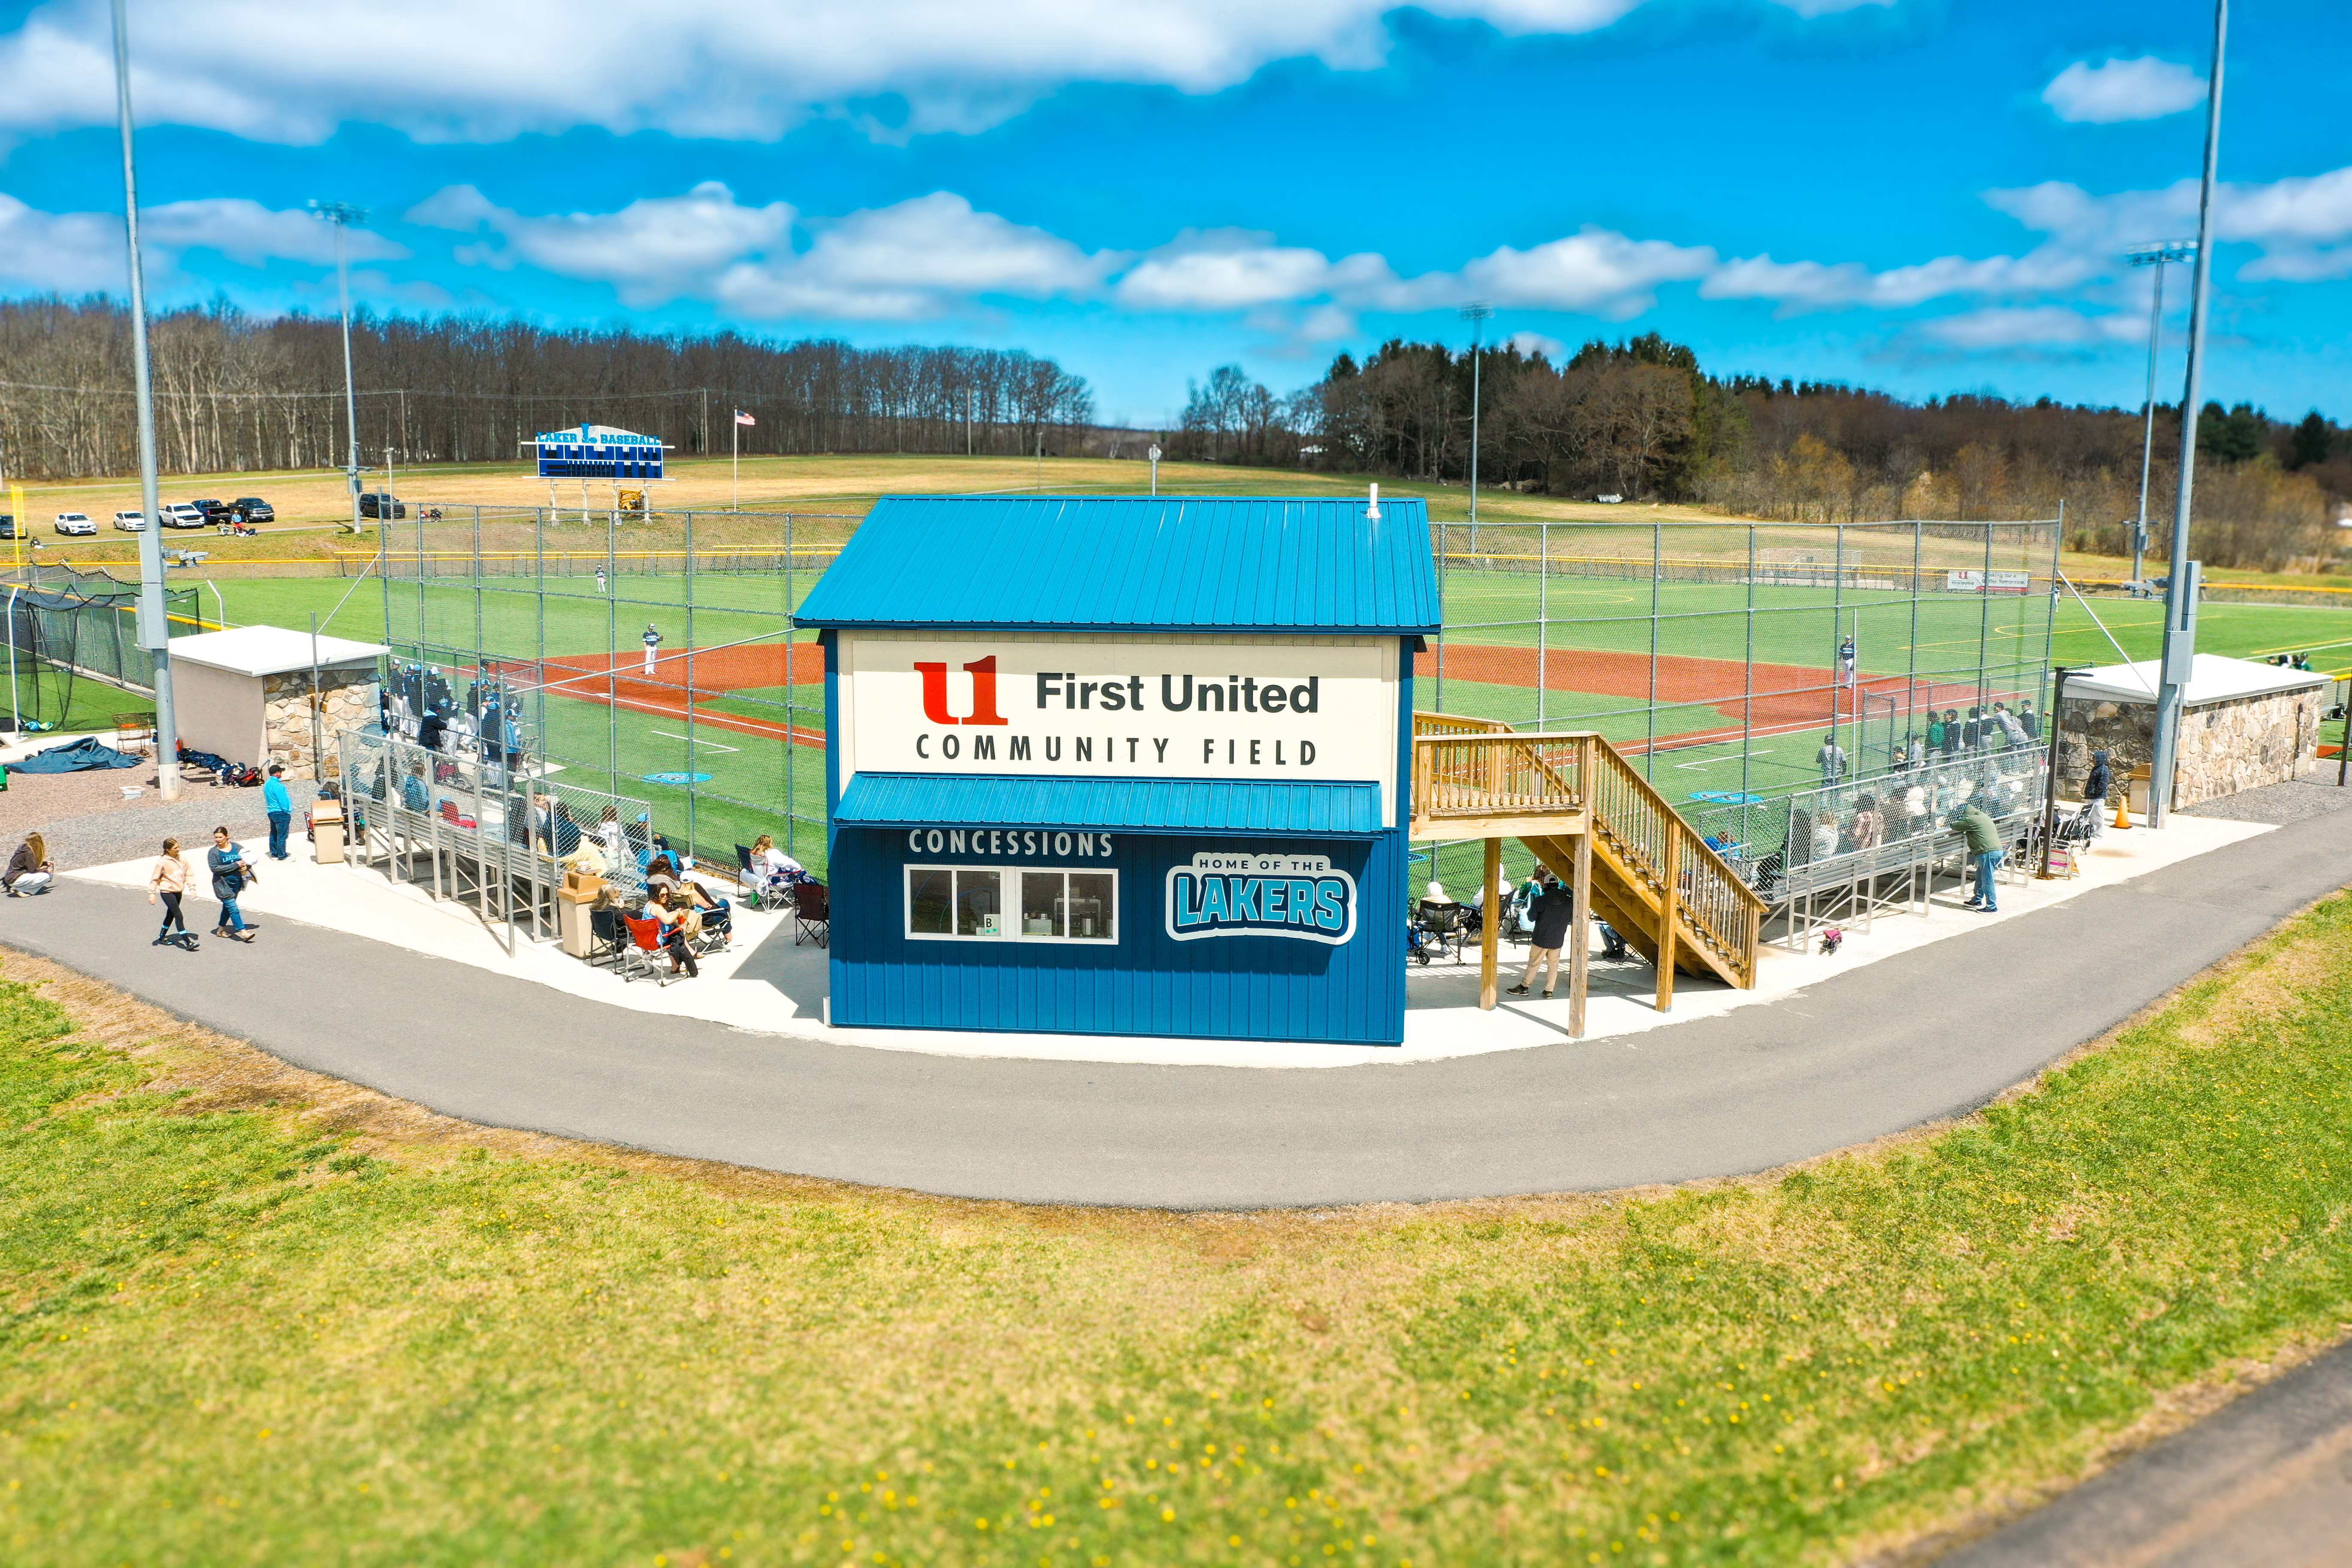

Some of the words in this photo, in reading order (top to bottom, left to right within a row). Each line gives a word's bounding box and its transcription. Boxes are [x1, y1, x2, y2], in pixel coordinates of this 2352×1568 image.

[537, 432, 577, 443] LAKER
[600, 434, 661, 445] BASEBALL
[1037, 673, 1144, 710] First
[1161, 674, 1318, 714] United
[916, 735, 1169, 763] COMMUNITY
[1204, 739, 1316, 765] FIELD
[909, 830, 1112, 857] CONCESSIONS
[1199, 859, 1249, 869] HOME
[1259, 861, 1281, 870] OF
[1291, 861, 1323, 871] THE
[1178, 877, 1343, 930] LAKERS
[986, 918, 992, 928] B
